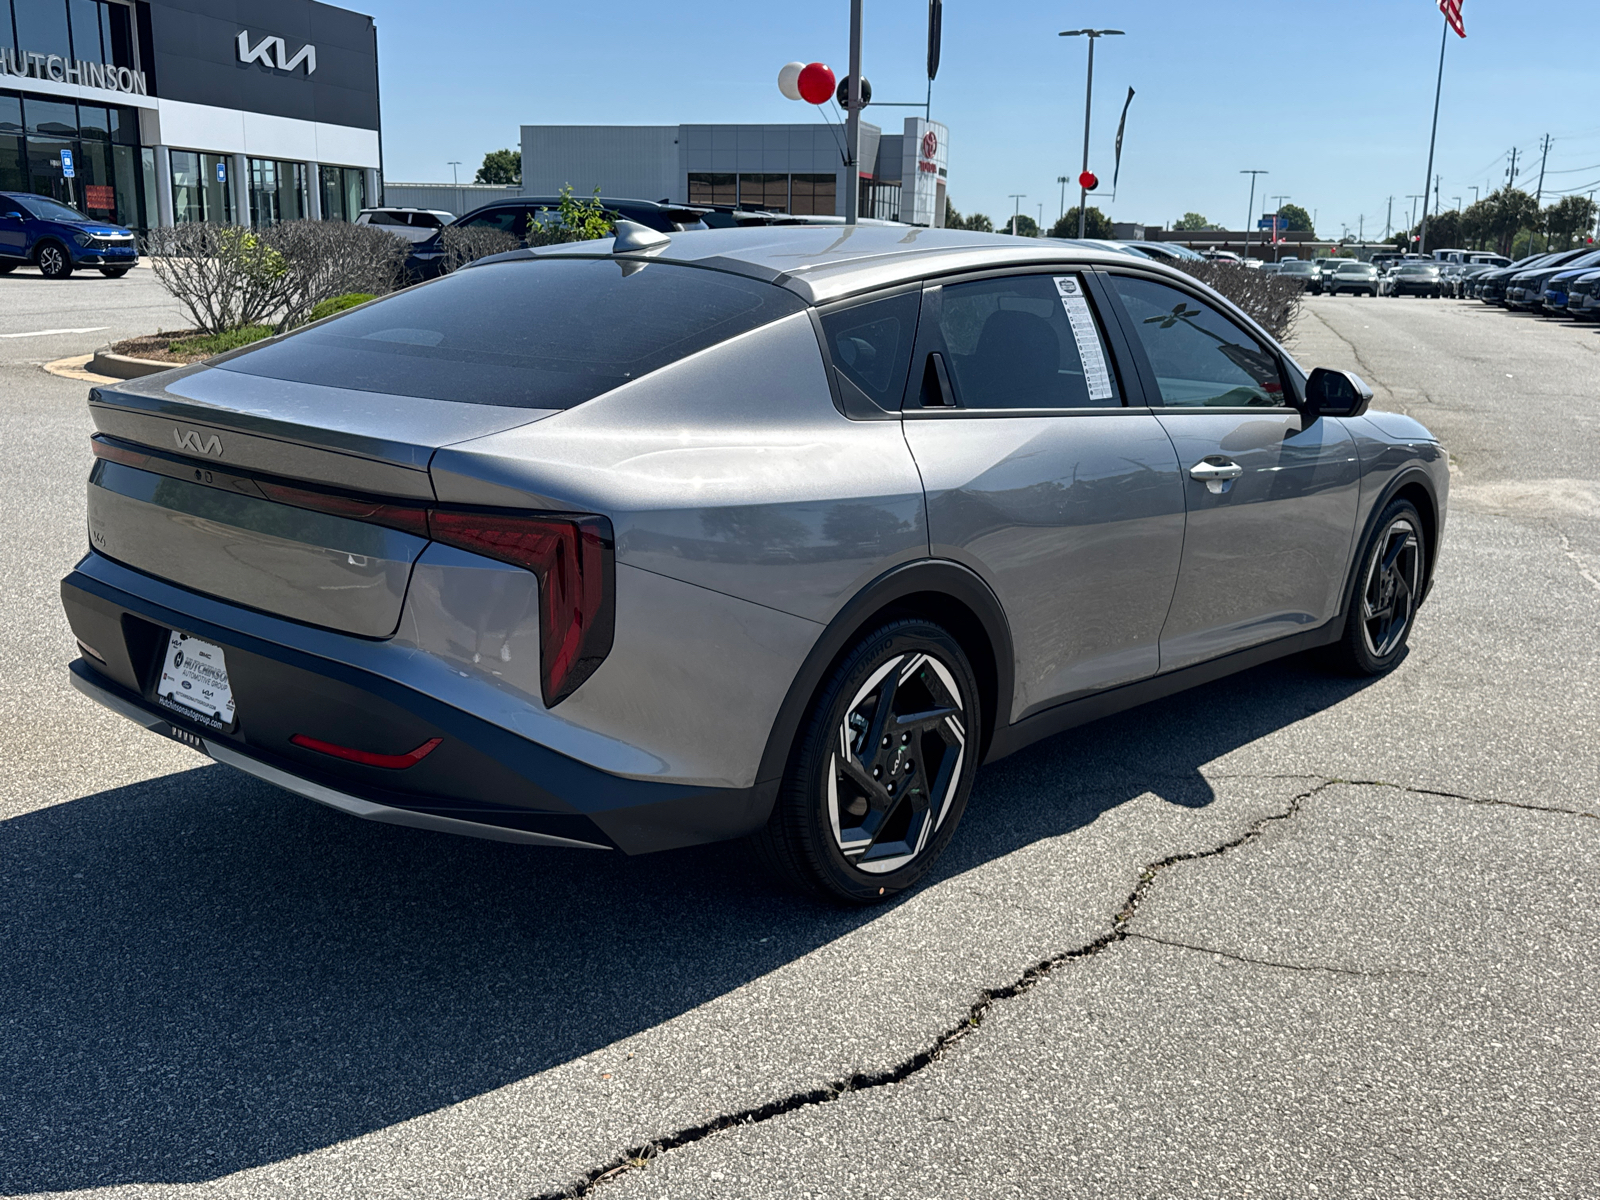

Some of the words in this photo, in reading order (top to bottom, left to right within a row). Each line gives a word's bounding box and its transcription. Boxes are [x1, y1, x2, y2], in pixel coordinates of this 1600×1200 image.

[237, 30, 316, 75] KIA
[173, 427, 224, 457] KIA
[848, 638, 893, 686] KUMHO
[182, 669, 211, 685] AUTOMOTIVE
[211, 680, 228, 691] GROUP
[202, 689, 214, 697] KIA
